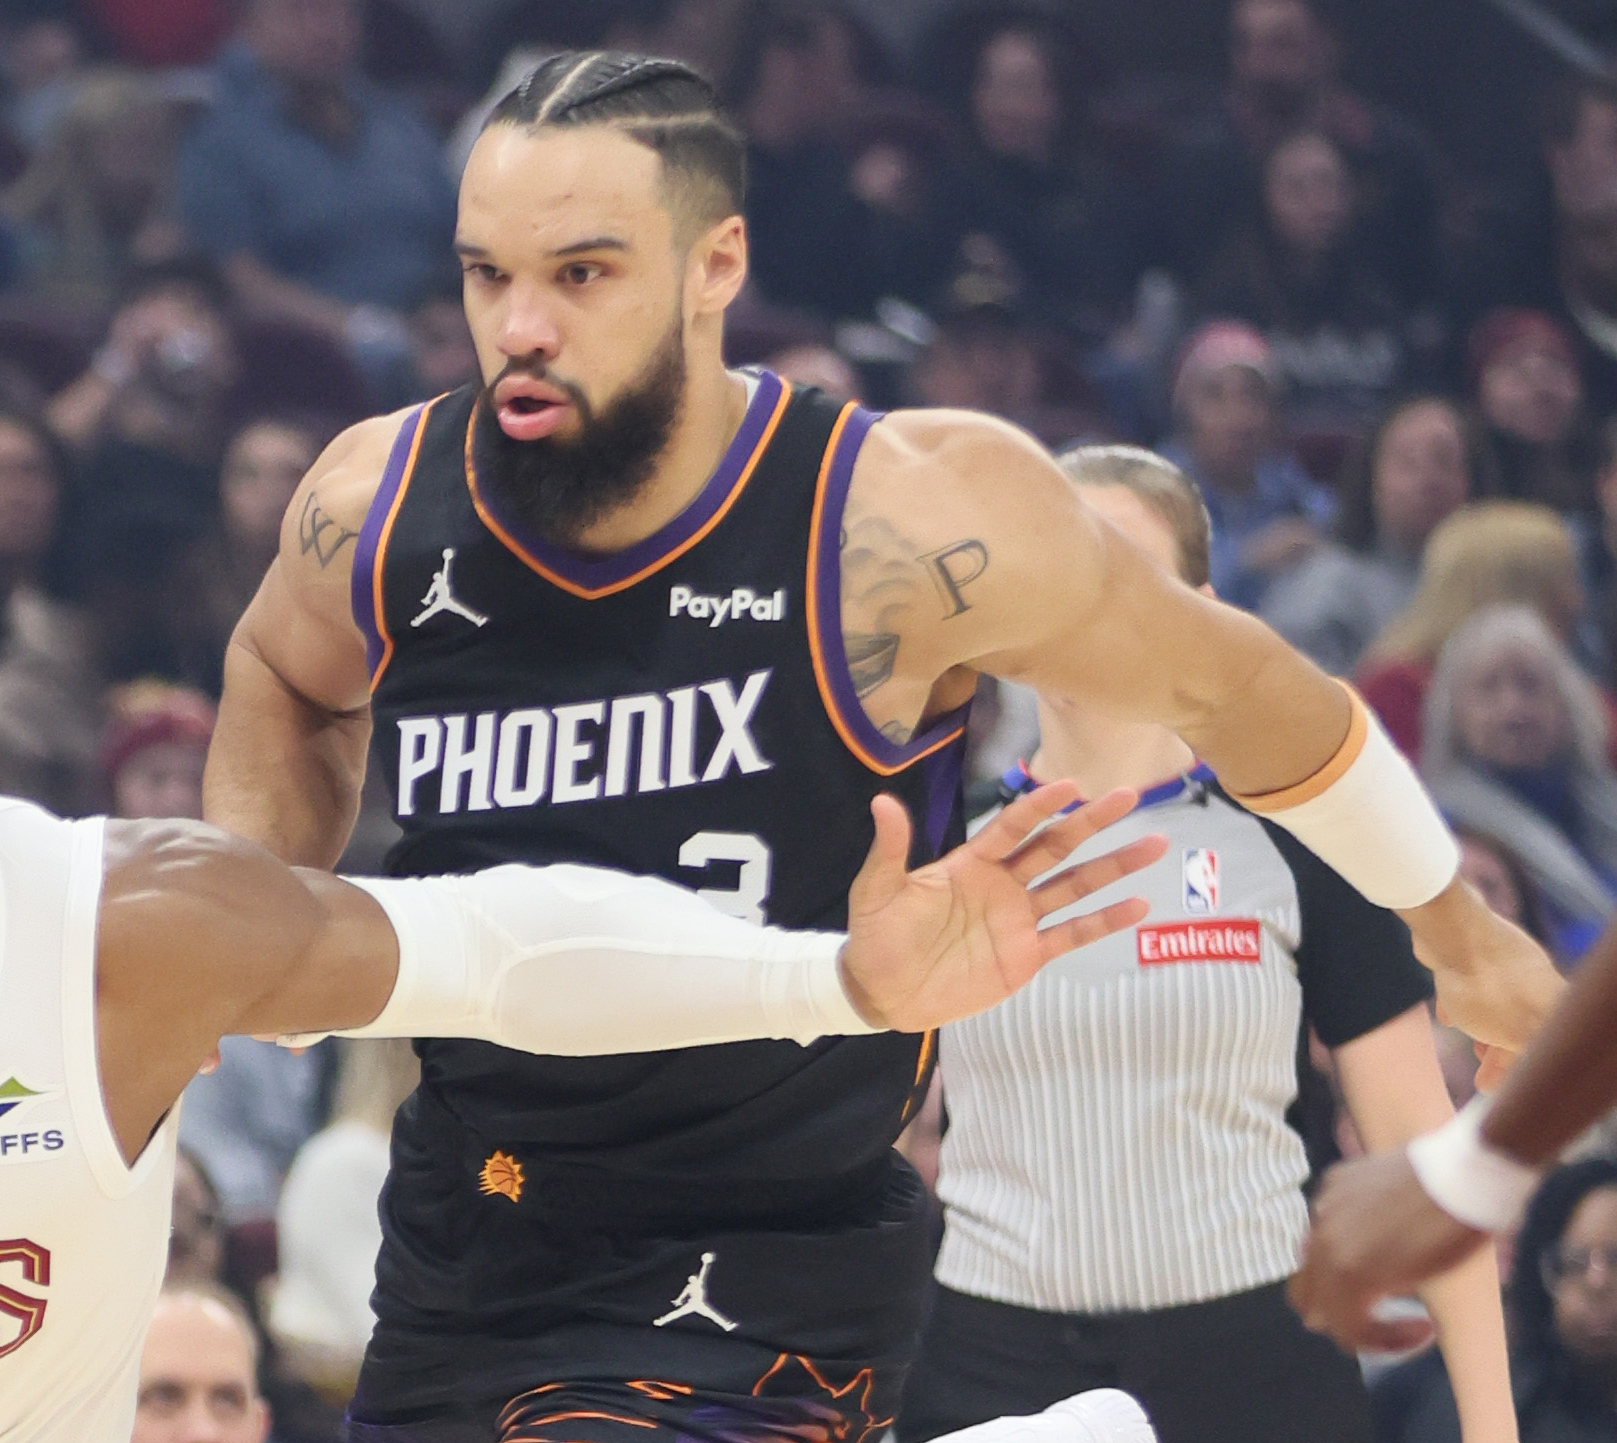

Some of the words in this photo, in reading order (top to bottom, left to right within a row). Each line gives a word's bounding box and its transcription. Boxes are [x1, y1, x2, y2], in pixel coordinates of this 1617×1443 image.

[668, 585, 784, 629] PayPal
[396, 668, 775, 816] PHOENIX
[1139, 925, 1259, 961] Emirates
